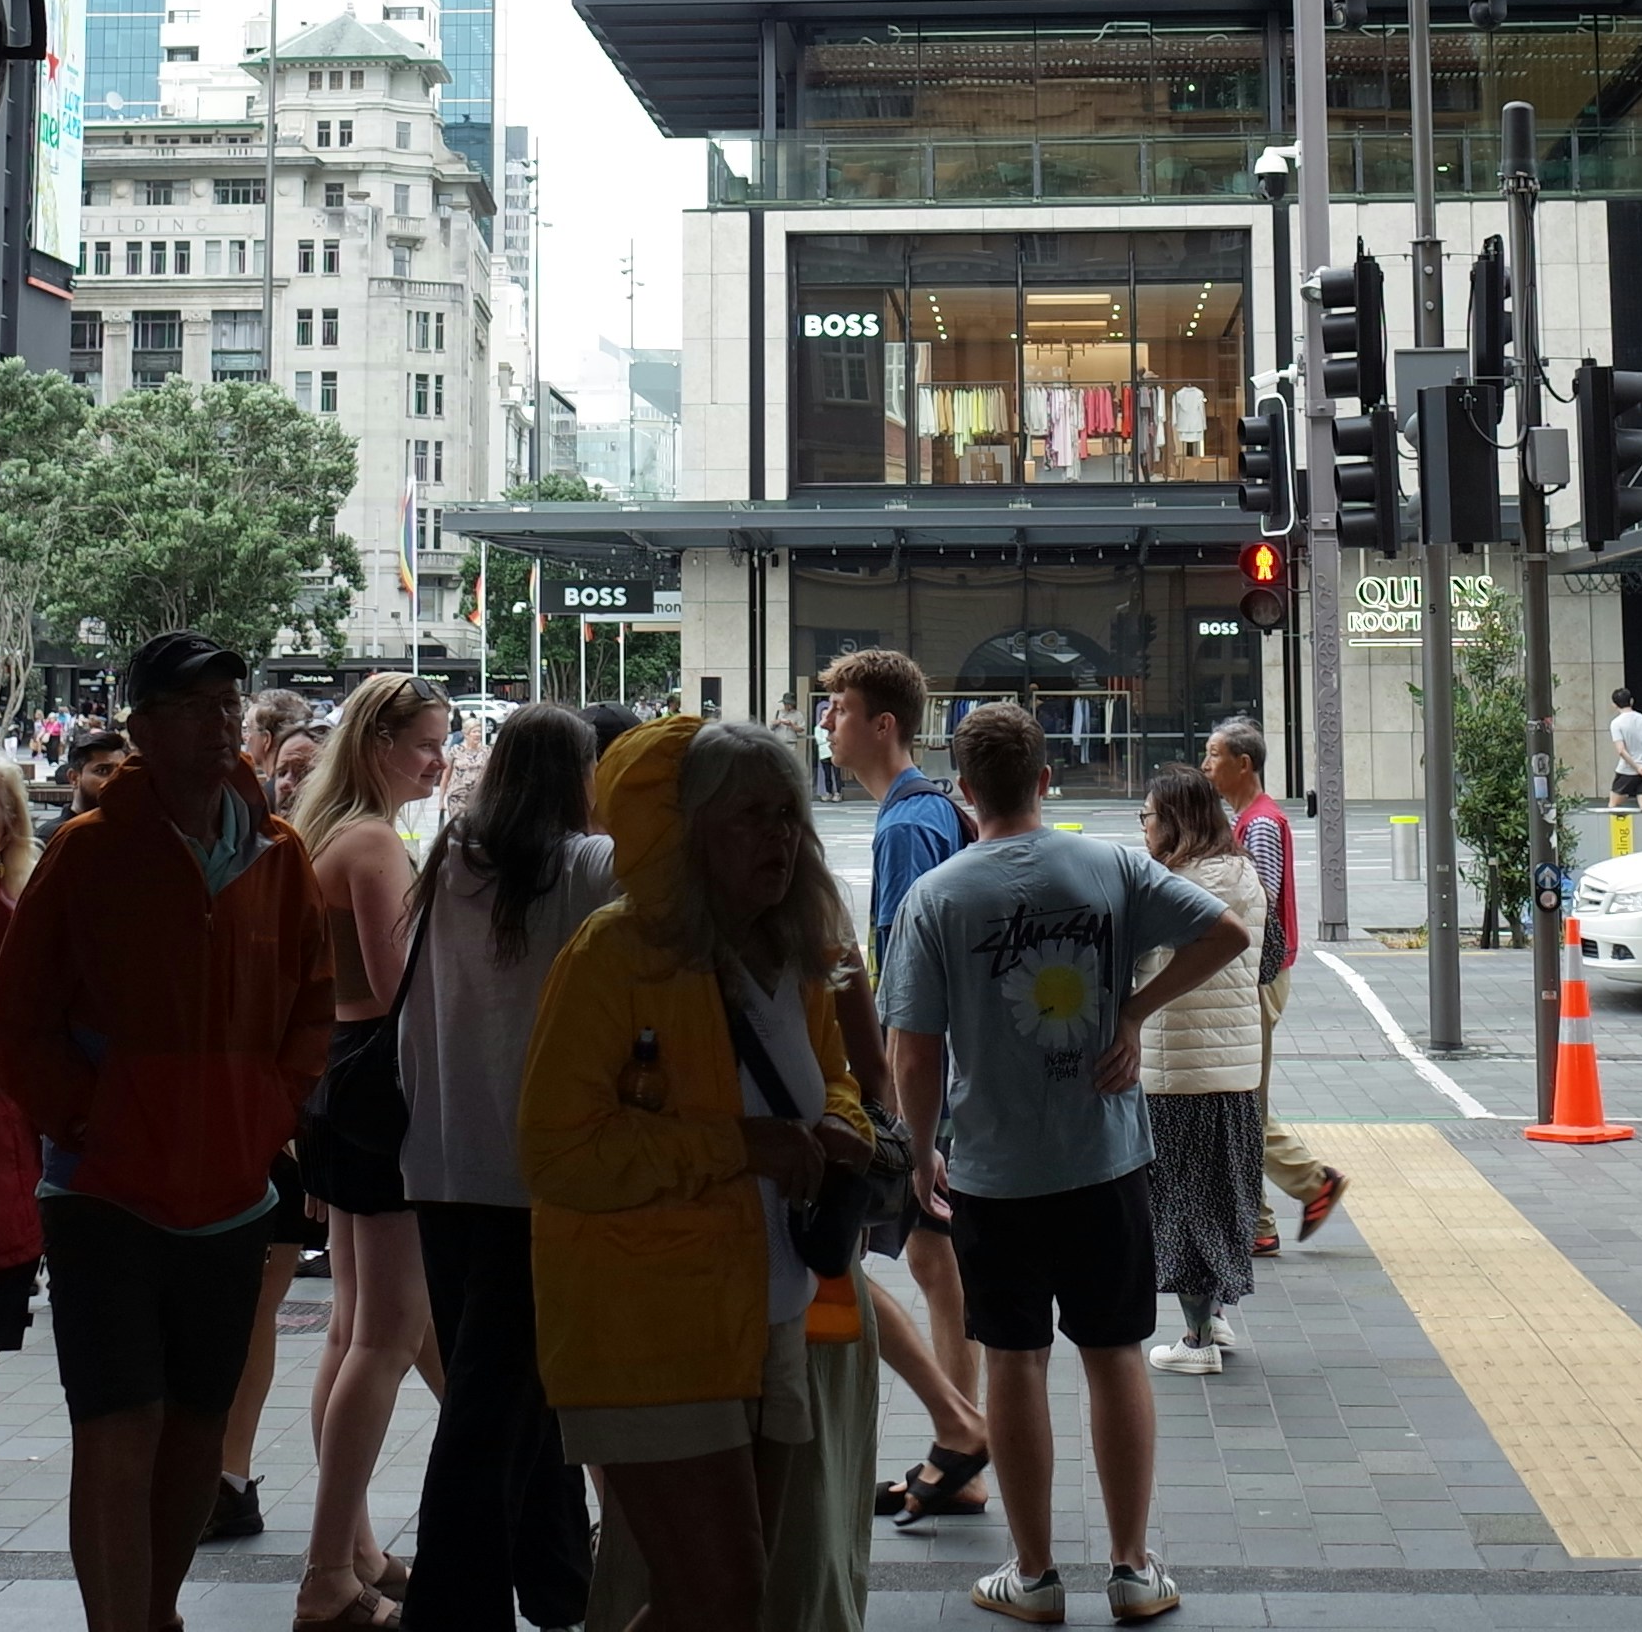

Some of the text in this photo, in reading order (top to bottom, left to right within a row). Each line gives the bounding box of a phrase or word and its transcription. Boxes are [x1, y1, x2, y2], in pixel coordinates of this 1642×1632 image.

[804, 313, 880, 337] BOSS
[564, 587, 627, 607] BOSS
[1356, 576, 1493, 611] QUNS
[1199, 622, 1239, 636] BOSS
